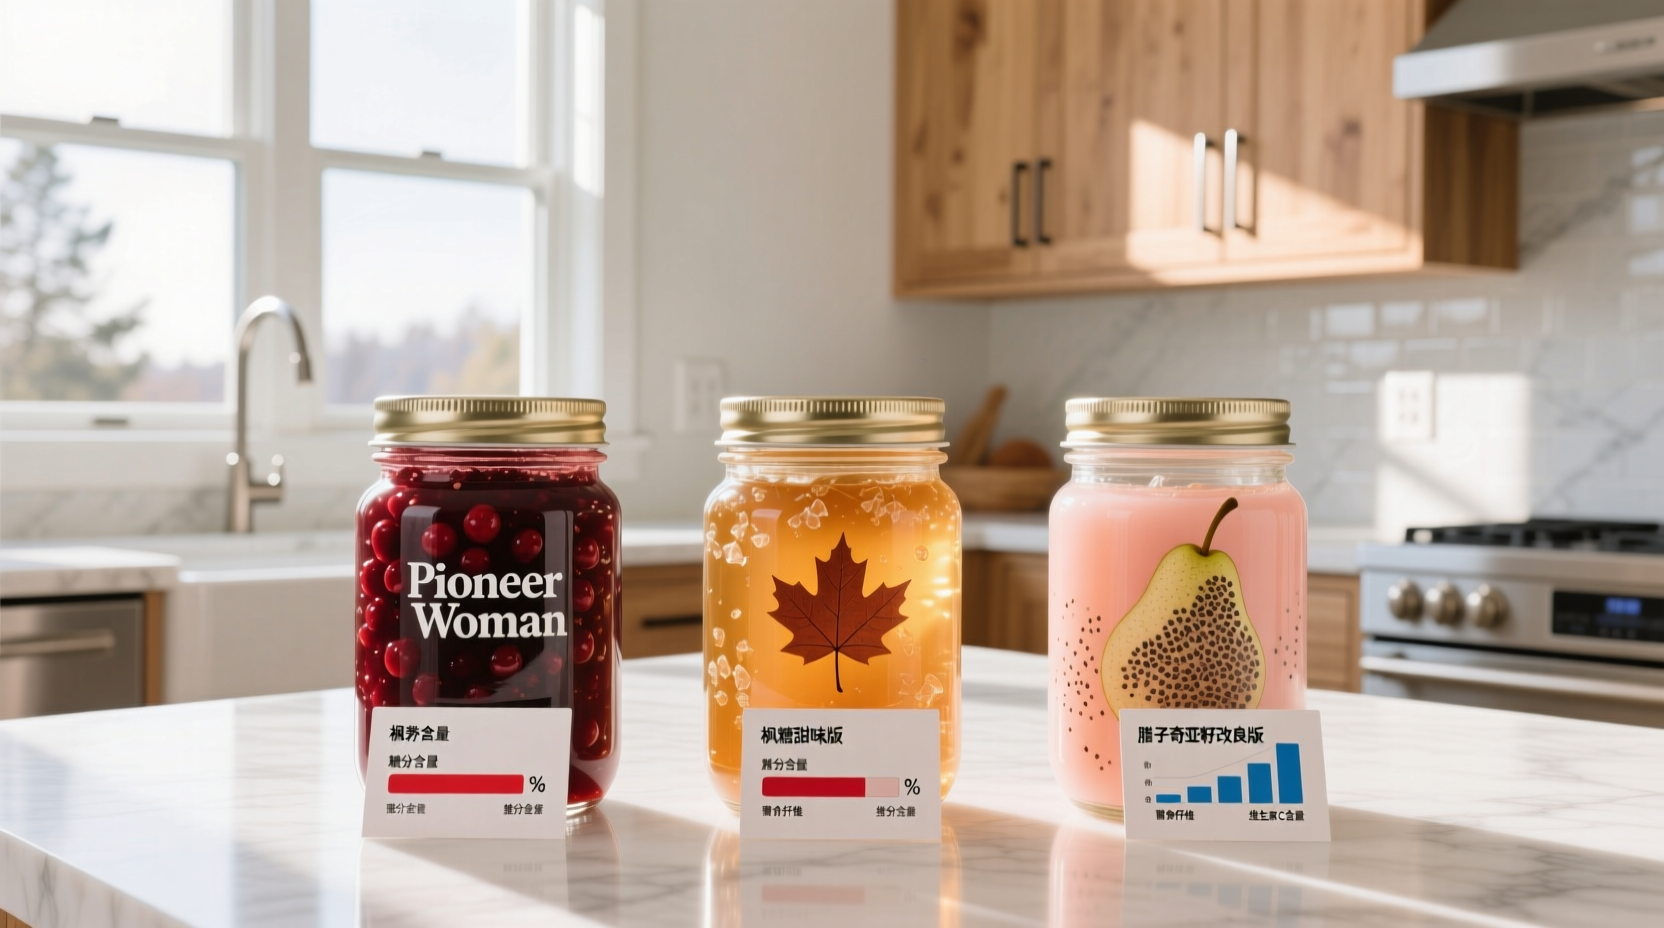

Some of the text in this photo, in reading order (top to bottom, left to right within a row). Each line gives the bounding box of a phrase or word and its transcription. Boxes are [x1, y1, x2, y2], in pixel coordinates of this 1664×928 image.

[407, 561, 563, 600] Pioneer
[411, 602, 568, 639] Woman
[529, 775, 546, 793] %
[904, 778, 921, 796] %
